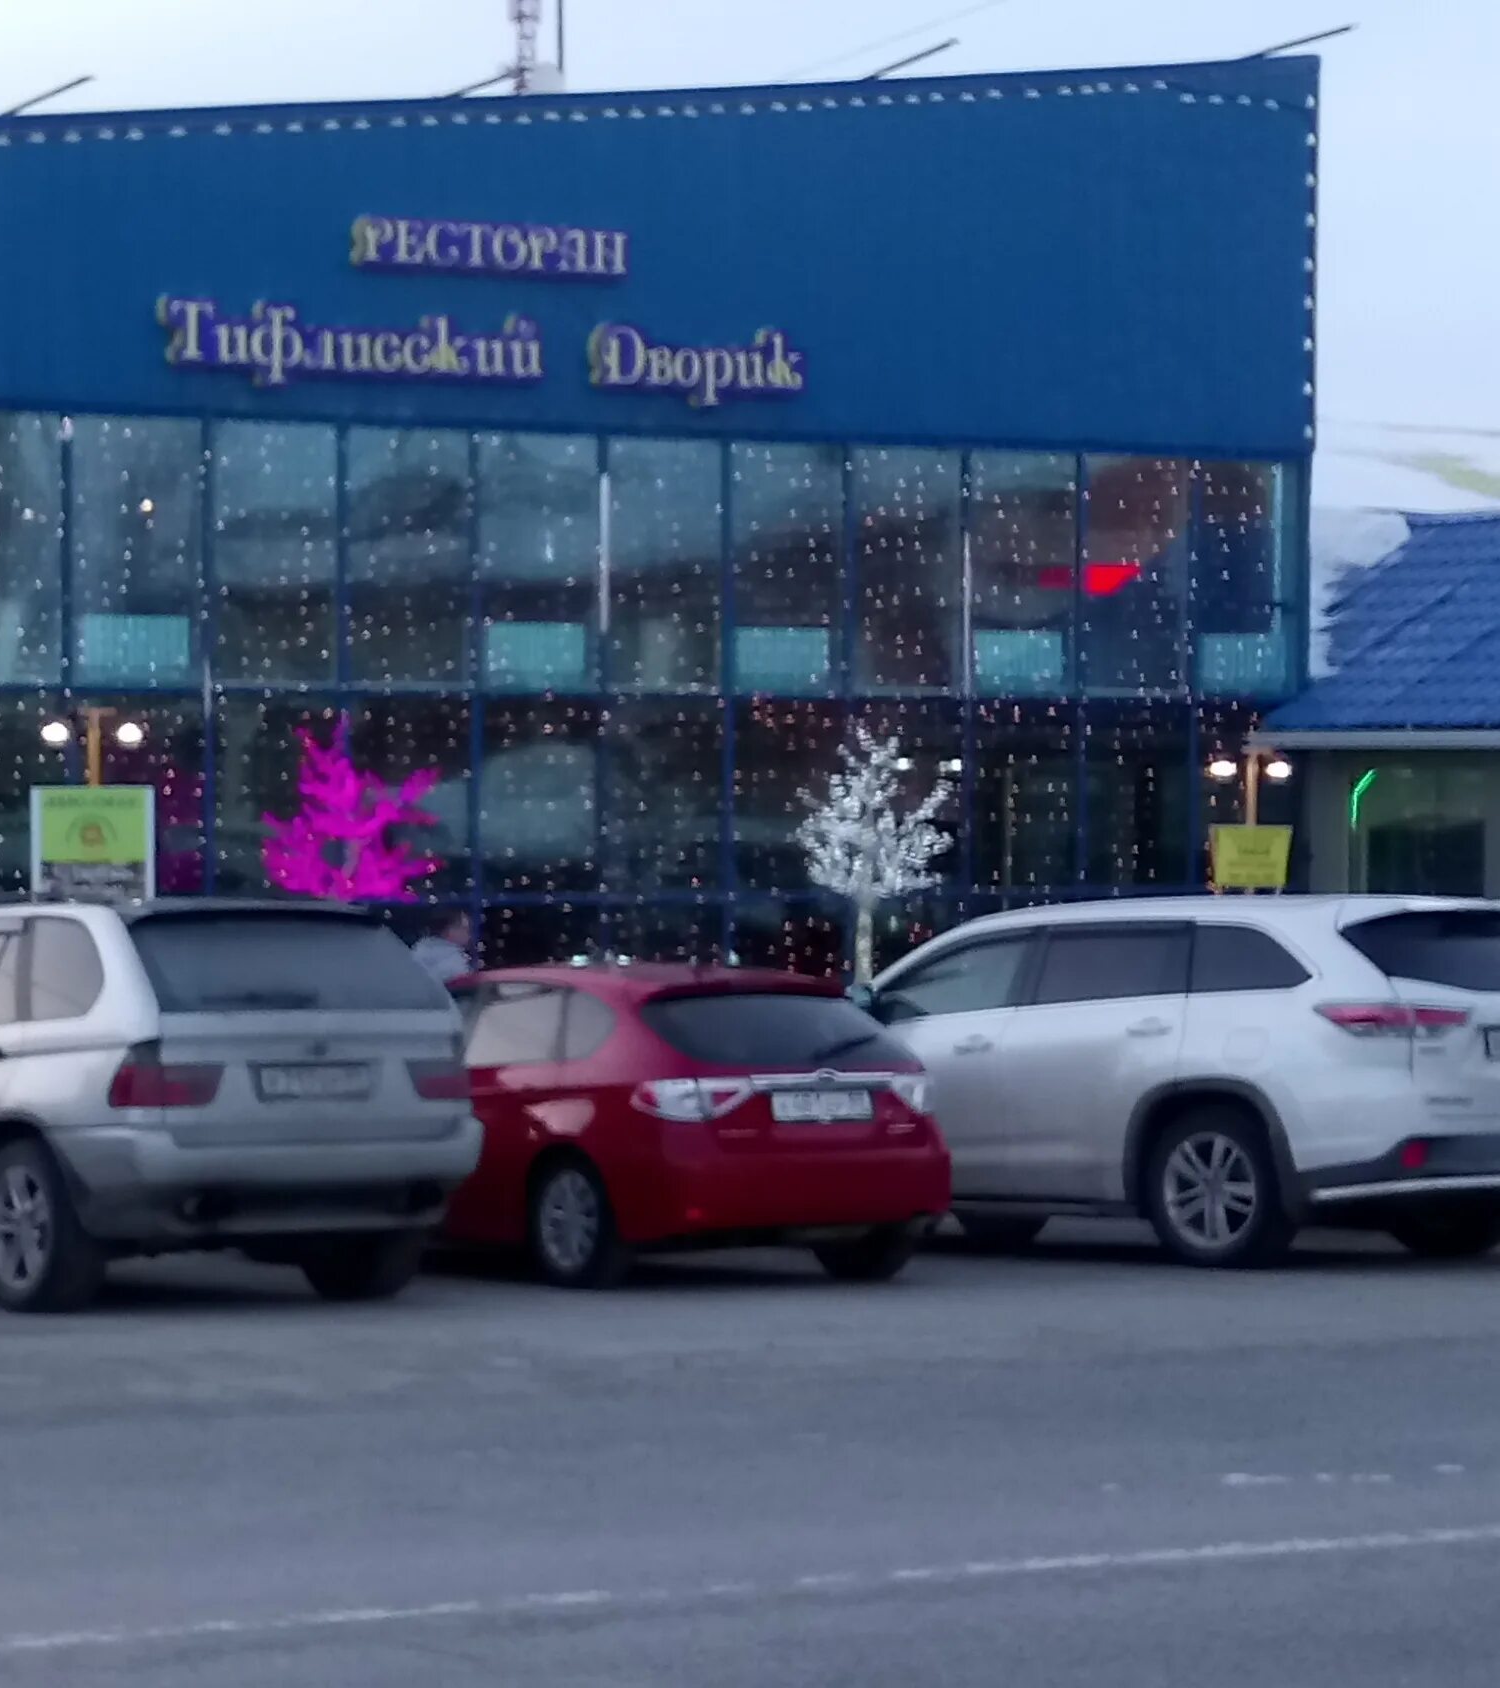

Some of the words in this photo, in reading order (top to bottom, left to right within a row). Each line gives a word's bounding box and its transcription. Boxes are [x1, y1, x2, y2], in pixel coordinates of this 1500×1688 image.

[352, 216, 628, 275] РЕСТОРАН
[158, 294, 544, 386] Тифлисский
[590, 322, 804, 407] Дворик
